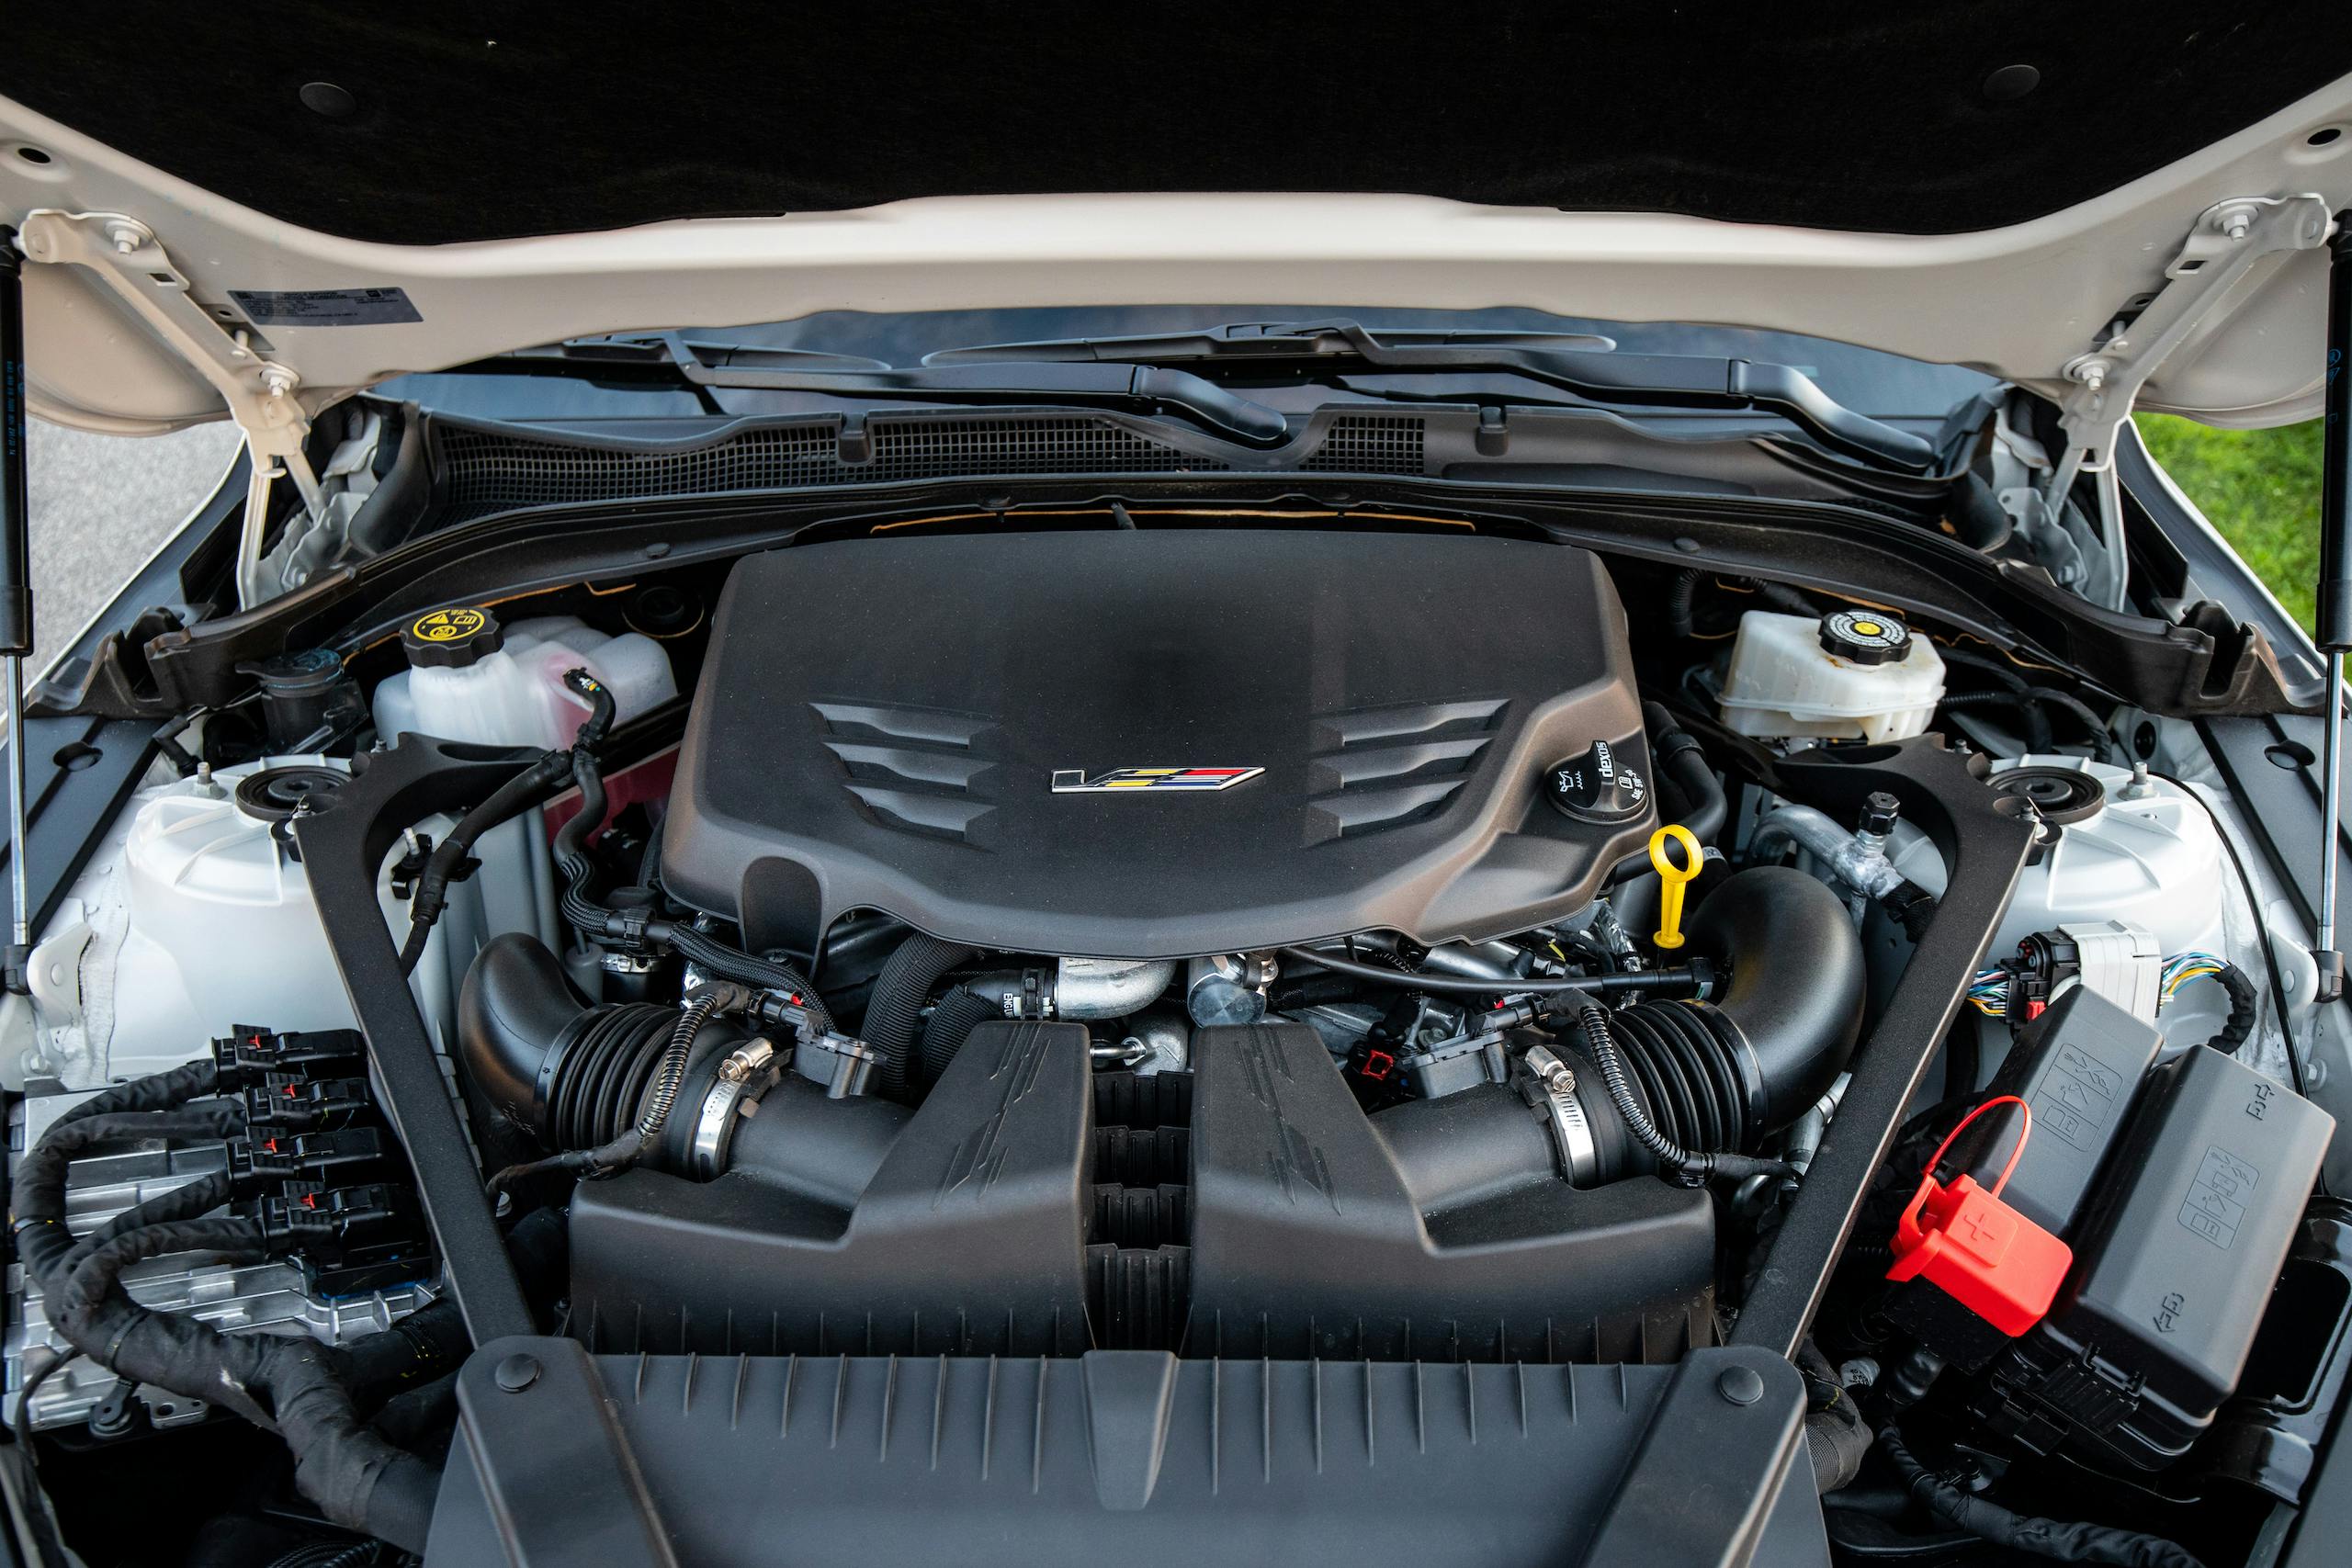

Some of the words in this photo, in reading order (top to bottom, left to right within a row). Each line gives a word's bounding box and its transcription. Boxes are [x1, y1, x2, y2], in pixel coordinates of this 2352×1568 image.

[1596, 741, 1614, 778] dexos
[1631, 788, 1643, 800] SAE
[1003, 993, 1013, 1009] ENG
